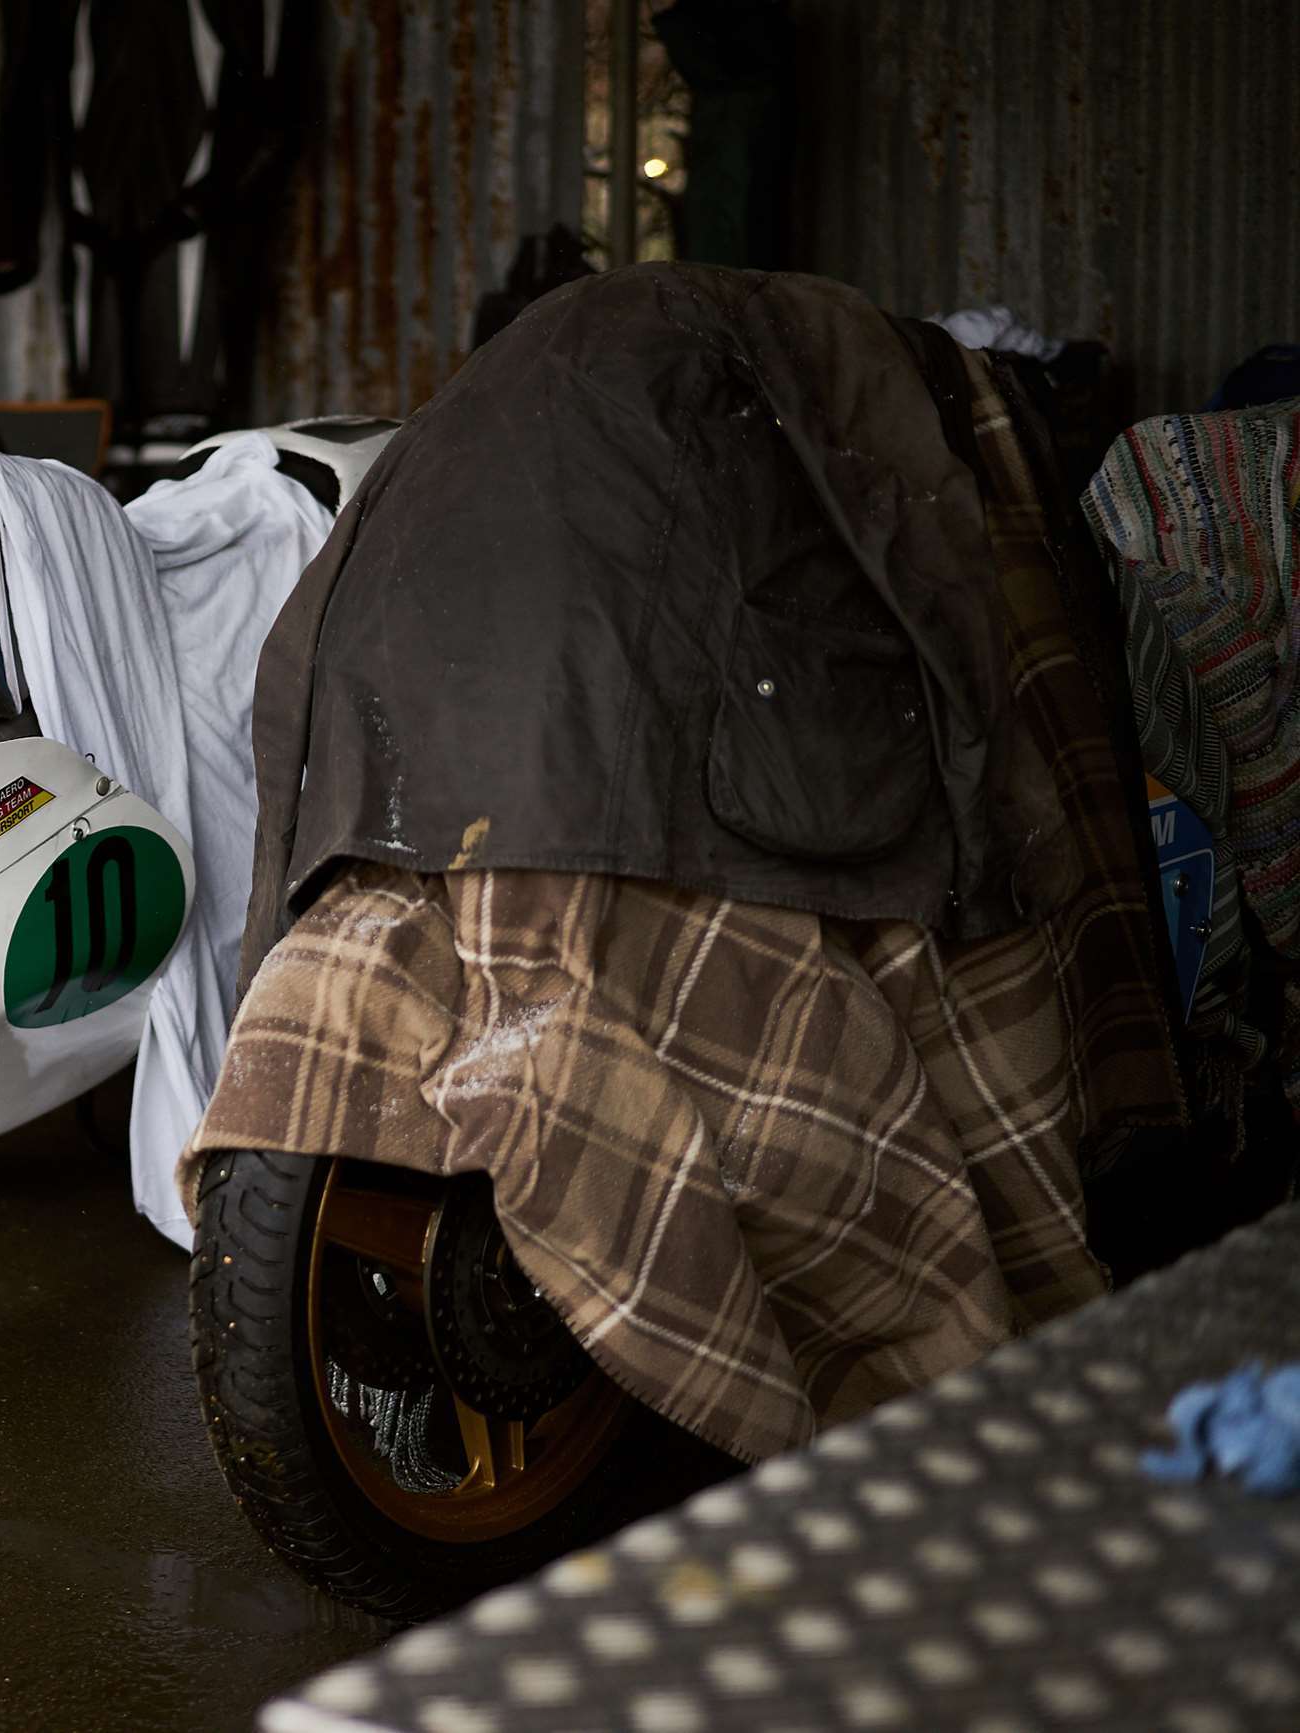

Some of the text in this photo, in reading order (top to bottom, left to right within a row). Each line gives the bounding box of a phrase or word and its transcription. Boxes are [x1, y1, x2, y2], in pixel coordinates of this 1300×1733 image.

[0, 778, 25, 802] AERO
[5, 787, 32, 811] TEAM
[34, 834, 137, 1015] 10
